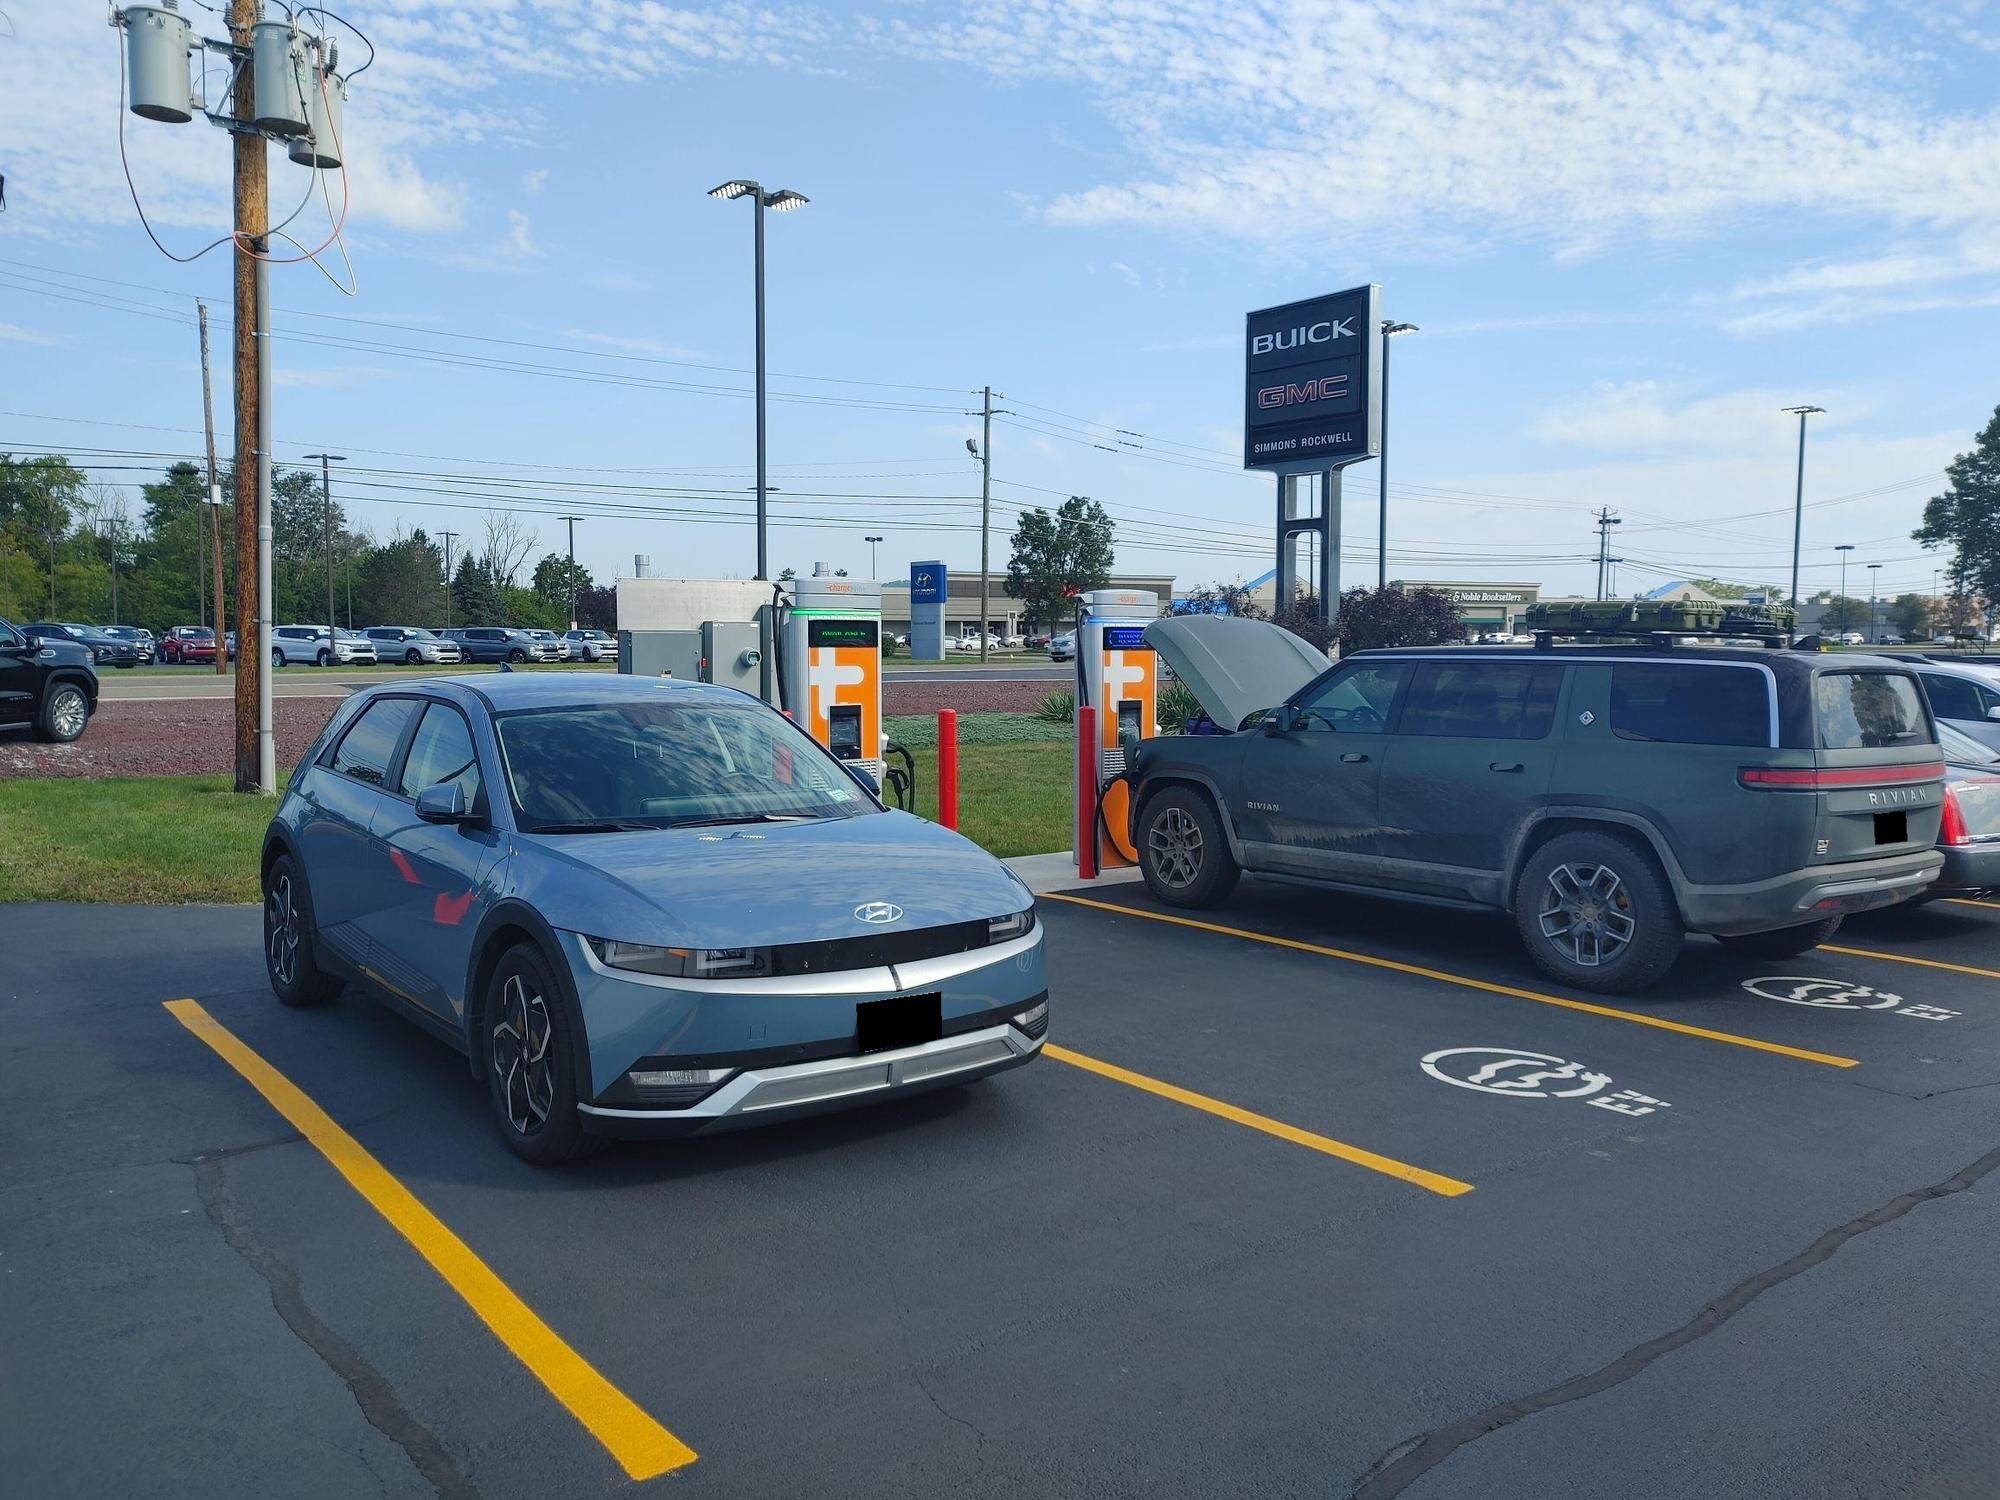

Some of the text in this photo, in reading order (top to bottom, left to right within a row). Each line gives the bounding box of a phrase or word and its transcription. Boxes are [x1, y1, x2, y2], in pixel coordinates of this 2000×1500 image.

[1252, 316, 1357, 355] BUICK
[1258, 374, 1348, 409] GMC
[1254, 431, 1353, 453] SIMMONS ROCKWELL
[1452, 591, 1460, 602] &
[1460, 592, 1481, 601] Noble
[1481, 592, 1522, 601] Booksellers
[1247, 801, 1280, 811] RIVIAN
[1868, 788, 1927, 805] RIVIAN
